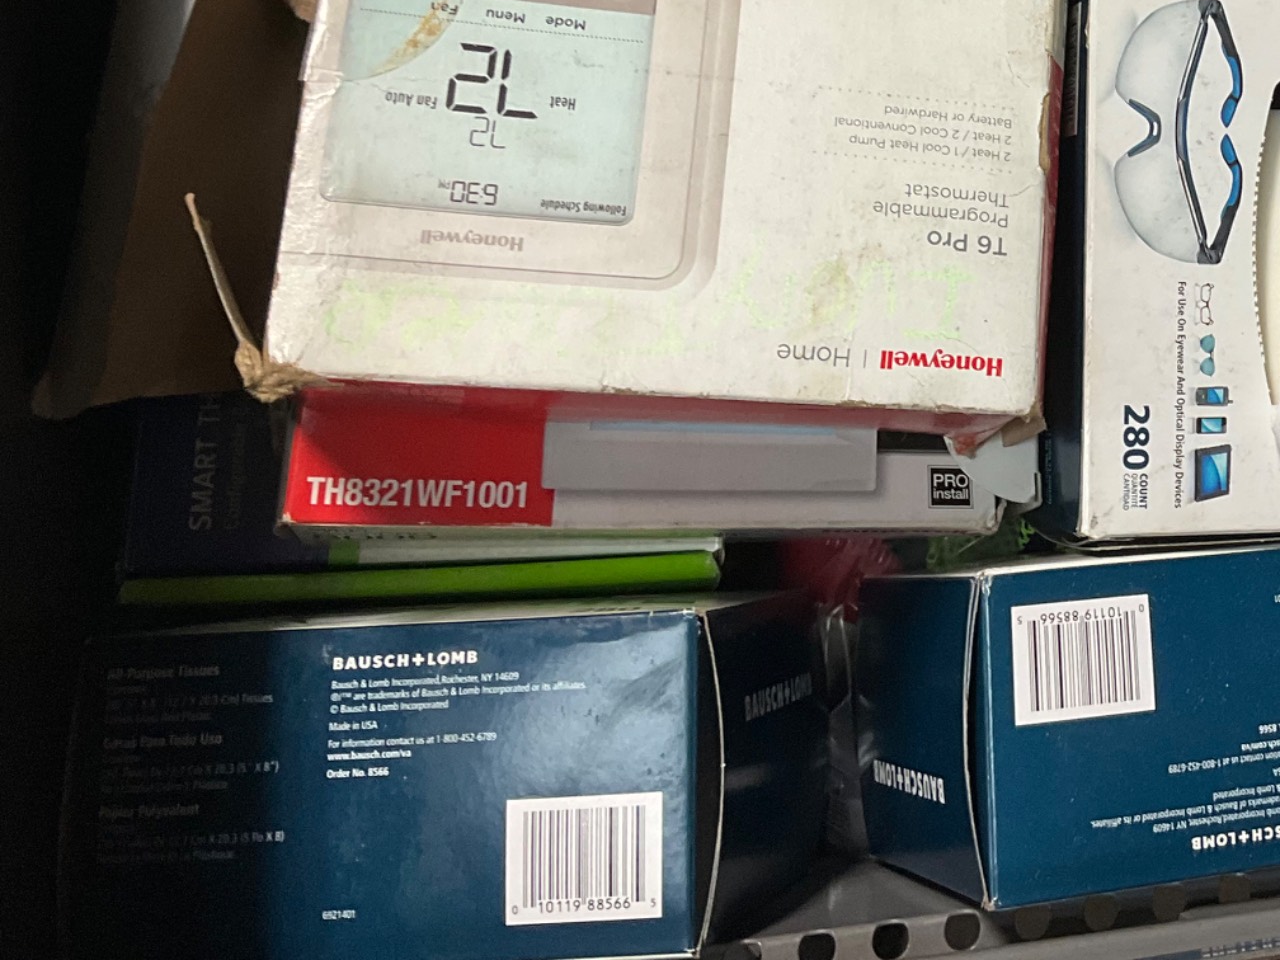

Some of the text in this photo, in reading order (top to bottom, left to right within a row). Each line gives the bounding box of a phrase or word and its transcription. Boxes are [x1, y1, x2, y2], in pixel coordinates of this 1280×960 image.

[429, 1, 586, 30] Mode Menu Fan
[443, 40, 545, 121] 72
[383, 90, 438, 109] Fan Auto
[548, 94, 576, 111] Heat
[833, 115, 1002, 144] Heat Cool Conventional
[883, 104, 1012, 129] Battery Hardwired
[467, 115, 509, 150] 72
[847, 133, 1000, 160] Heat Cool Heat Pump
[448, 178, 499, 207] 6:30
[902, 182, 1010, 208] Thermostat
[539, 197, 627, 217] Following Schedule
[871, 199, 1009, 228] Programmable
[419, 225, 524, 252] Honeywell
[925, 228, 1008, 256] T6 Pro
[774, 341, 1004, 378] Honeywell Home
[1173, 280, 1186, 509] For Use On Eyewear And Optical Display Devices
[1122, 403, 1150, 471] 280
[187, 436, 219, 533] SMART
[304, 476, 527, 509] TH8321WF1001
[931, 473, 970, 490] PRO
[931, 486, 970, 502] install
[1122, 472, 1130, 511] CANTIDAD
[1138, 472, 1148, 510] COUNT
[1039, 606, 1122, 624] 10119 88566
[330, 649, 479, 671] BAUSCH+LOMB
[1257, 723, 1277, 734] 8566
[325, 766, 389, 779] Order 8566
[537, 896, 631, 913] 10119 88566
